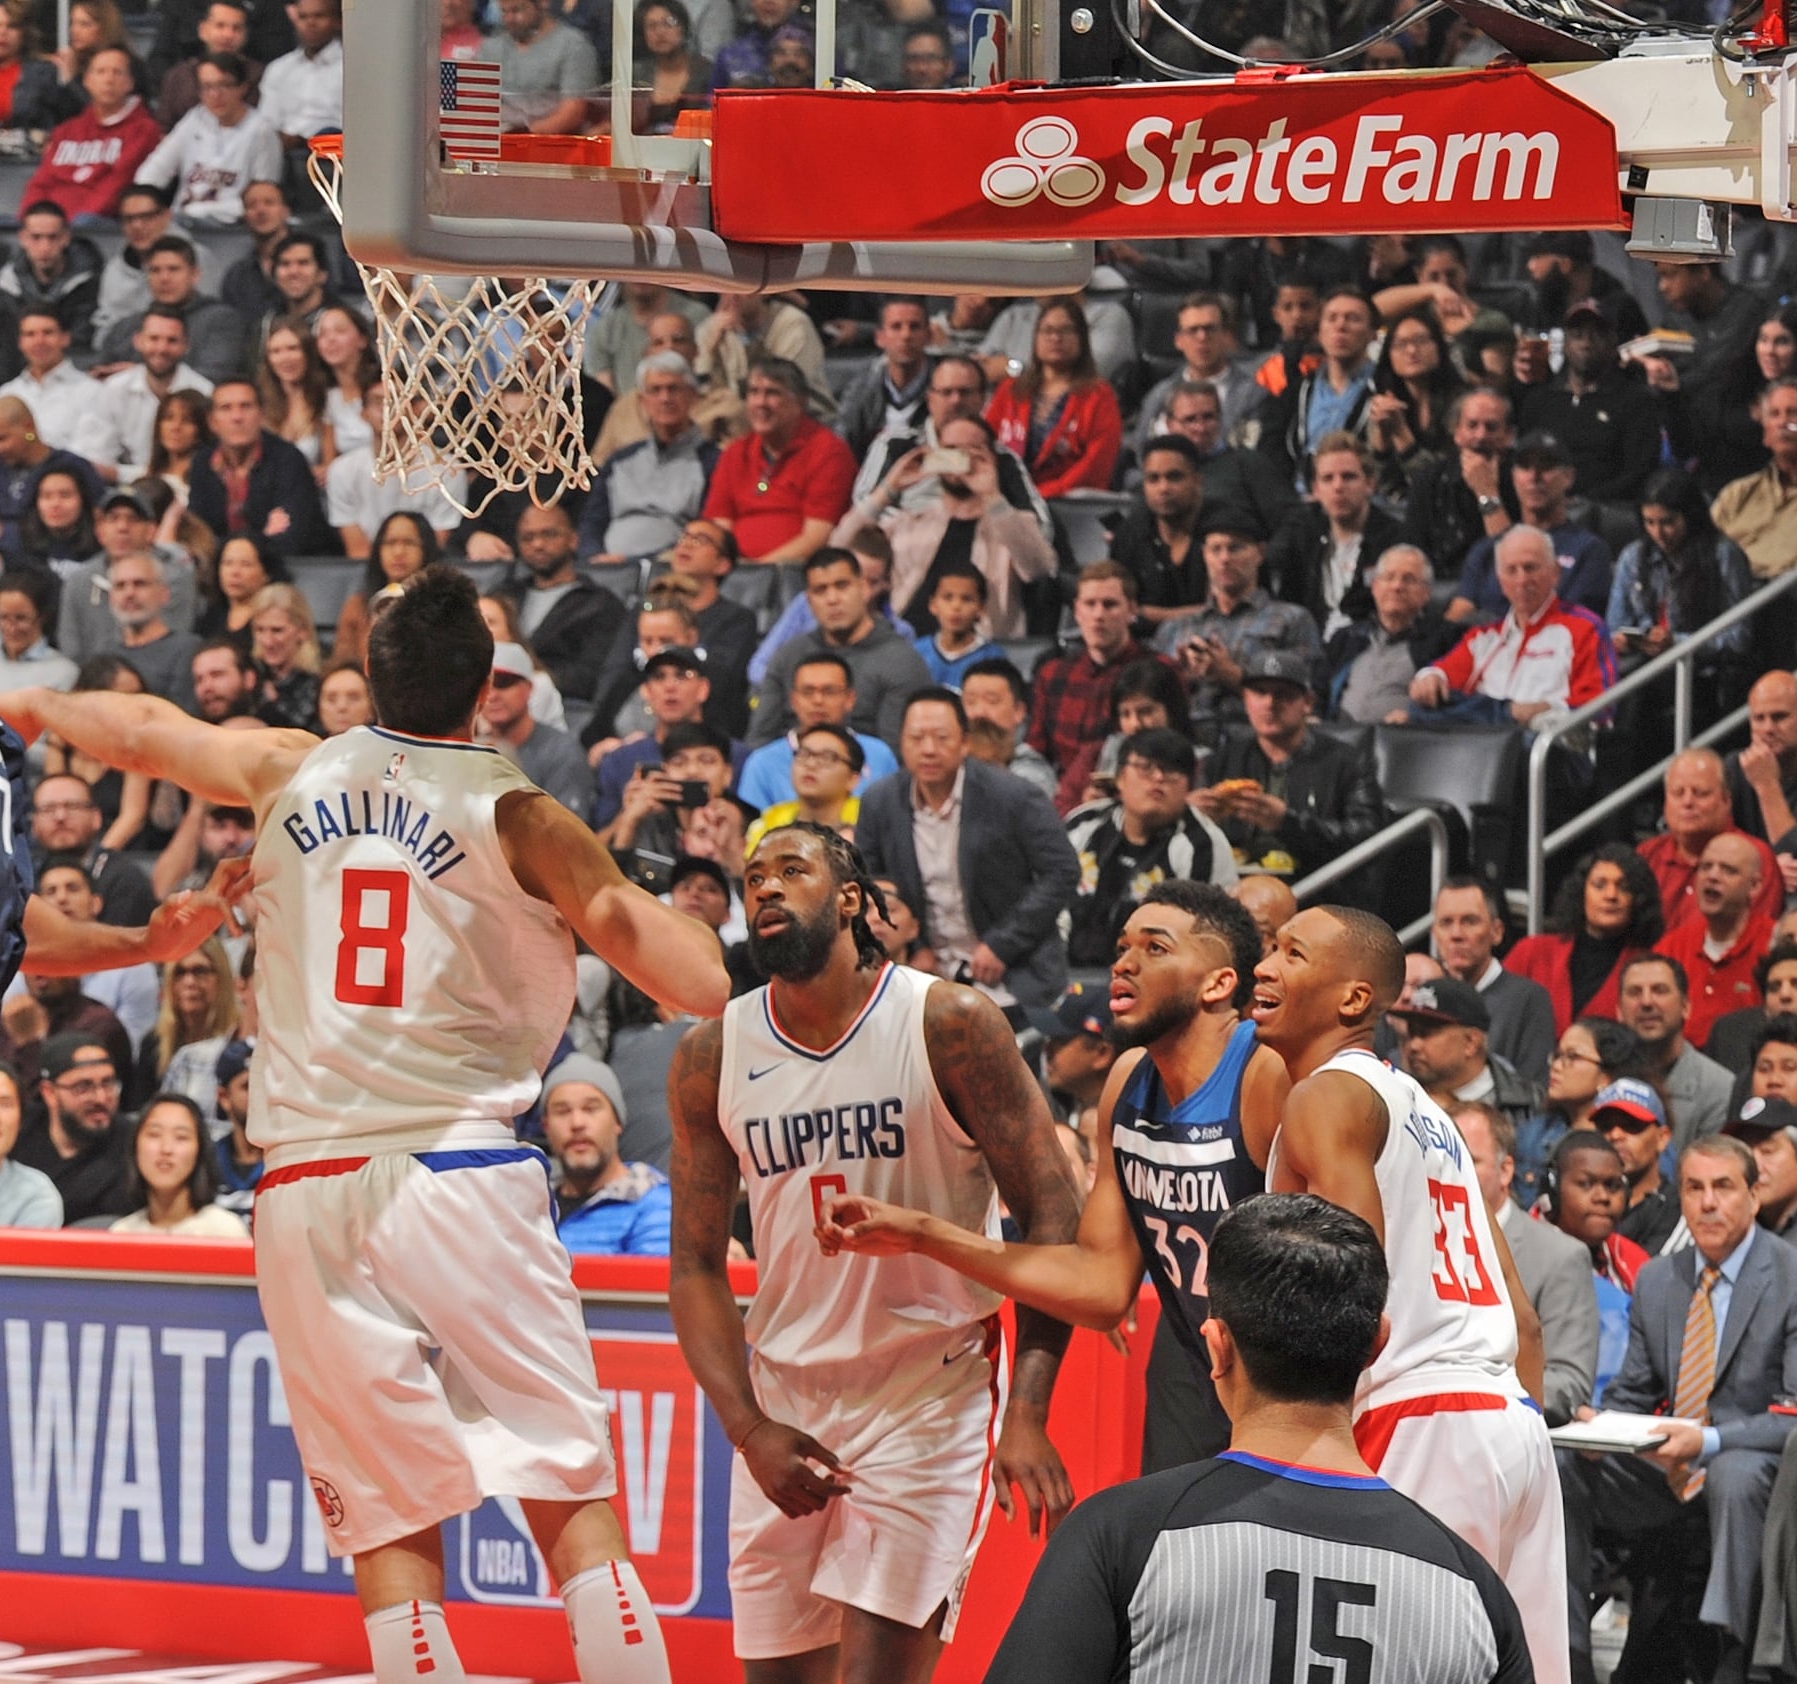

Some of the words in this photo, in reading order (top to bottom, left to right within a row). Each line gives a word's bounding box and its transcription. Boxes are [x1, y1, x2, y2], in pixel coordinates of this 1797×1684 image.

[282, 790, 467, 881] GALLINARI
[334, 867, 411, 1009] 8
[744, 1096, 906, 1178] CLIPPERS
[1143, 1214, 1210, 1298] 32
[1427, 1177, 1503, 1307] 33
[476, 1538, 528, 1585] NBA
[1264, 1569, 1376, 1684] 15
